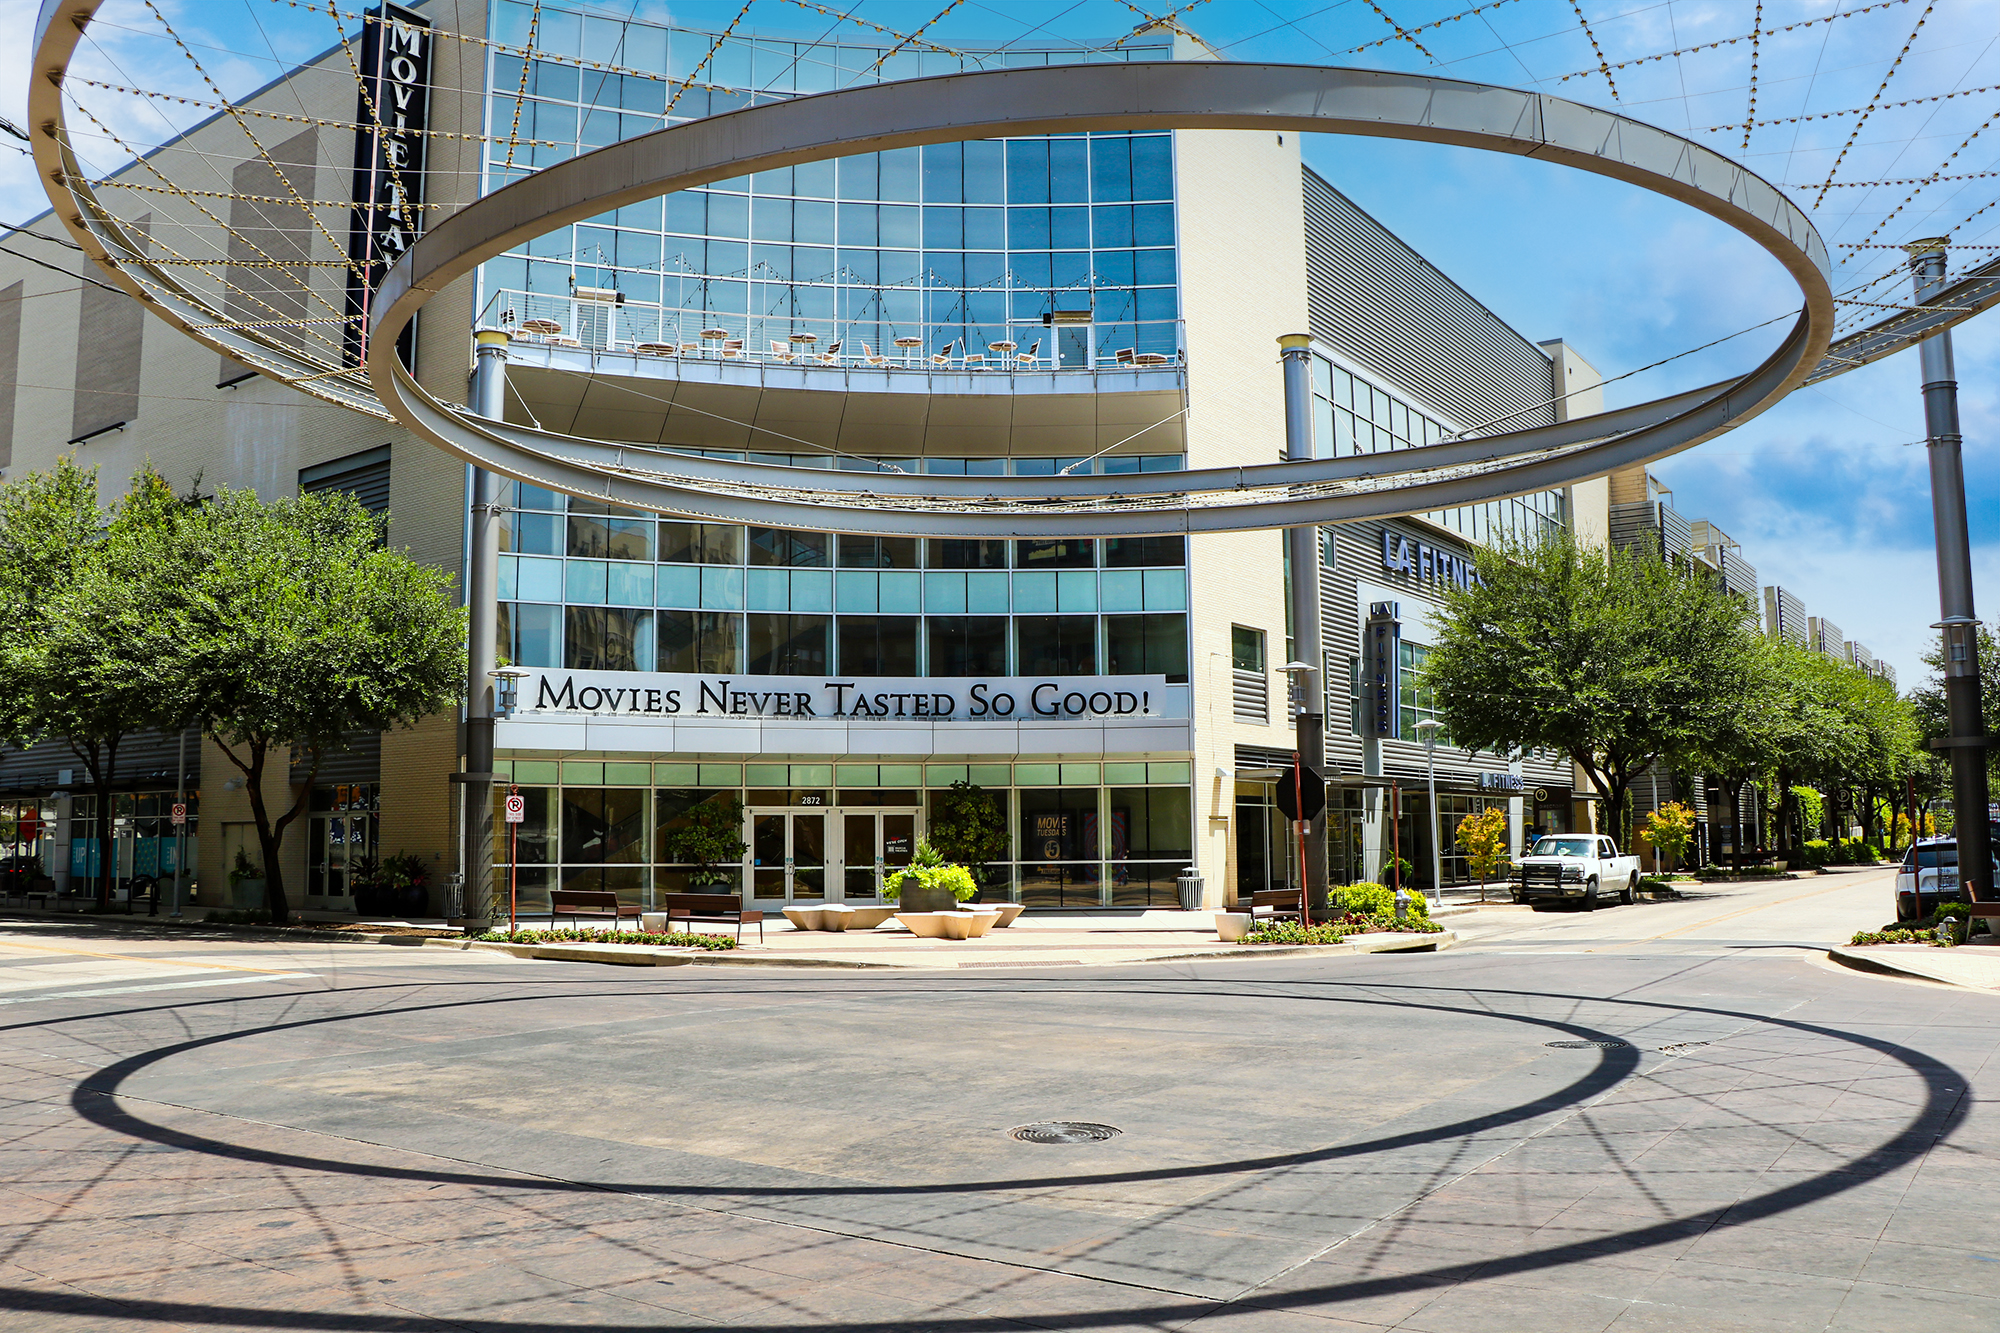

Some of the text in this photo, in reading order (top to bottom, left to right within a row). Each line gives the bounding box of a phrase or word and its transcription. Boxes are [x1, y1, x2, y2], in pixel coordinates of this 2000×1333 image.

[1381, 529, 1488, 596] LA FITNE
[1370, 602, 1391, 616] LA
[1375, 626, 1388, 733] FITNESS
[534, 674, 1151, 717] MOVIES NEVER TASTED SO GOOD!
[1493, 773, 1525, 791] FITNESS
[801, 796, 821, 805] 2872
[1037, 816, 1068, 829] MOVIE
[1037, 828, 1067, 837] TUESDAS
[75, 846, 86, 864] UP
[1046, 842, 1058, 857] $5
